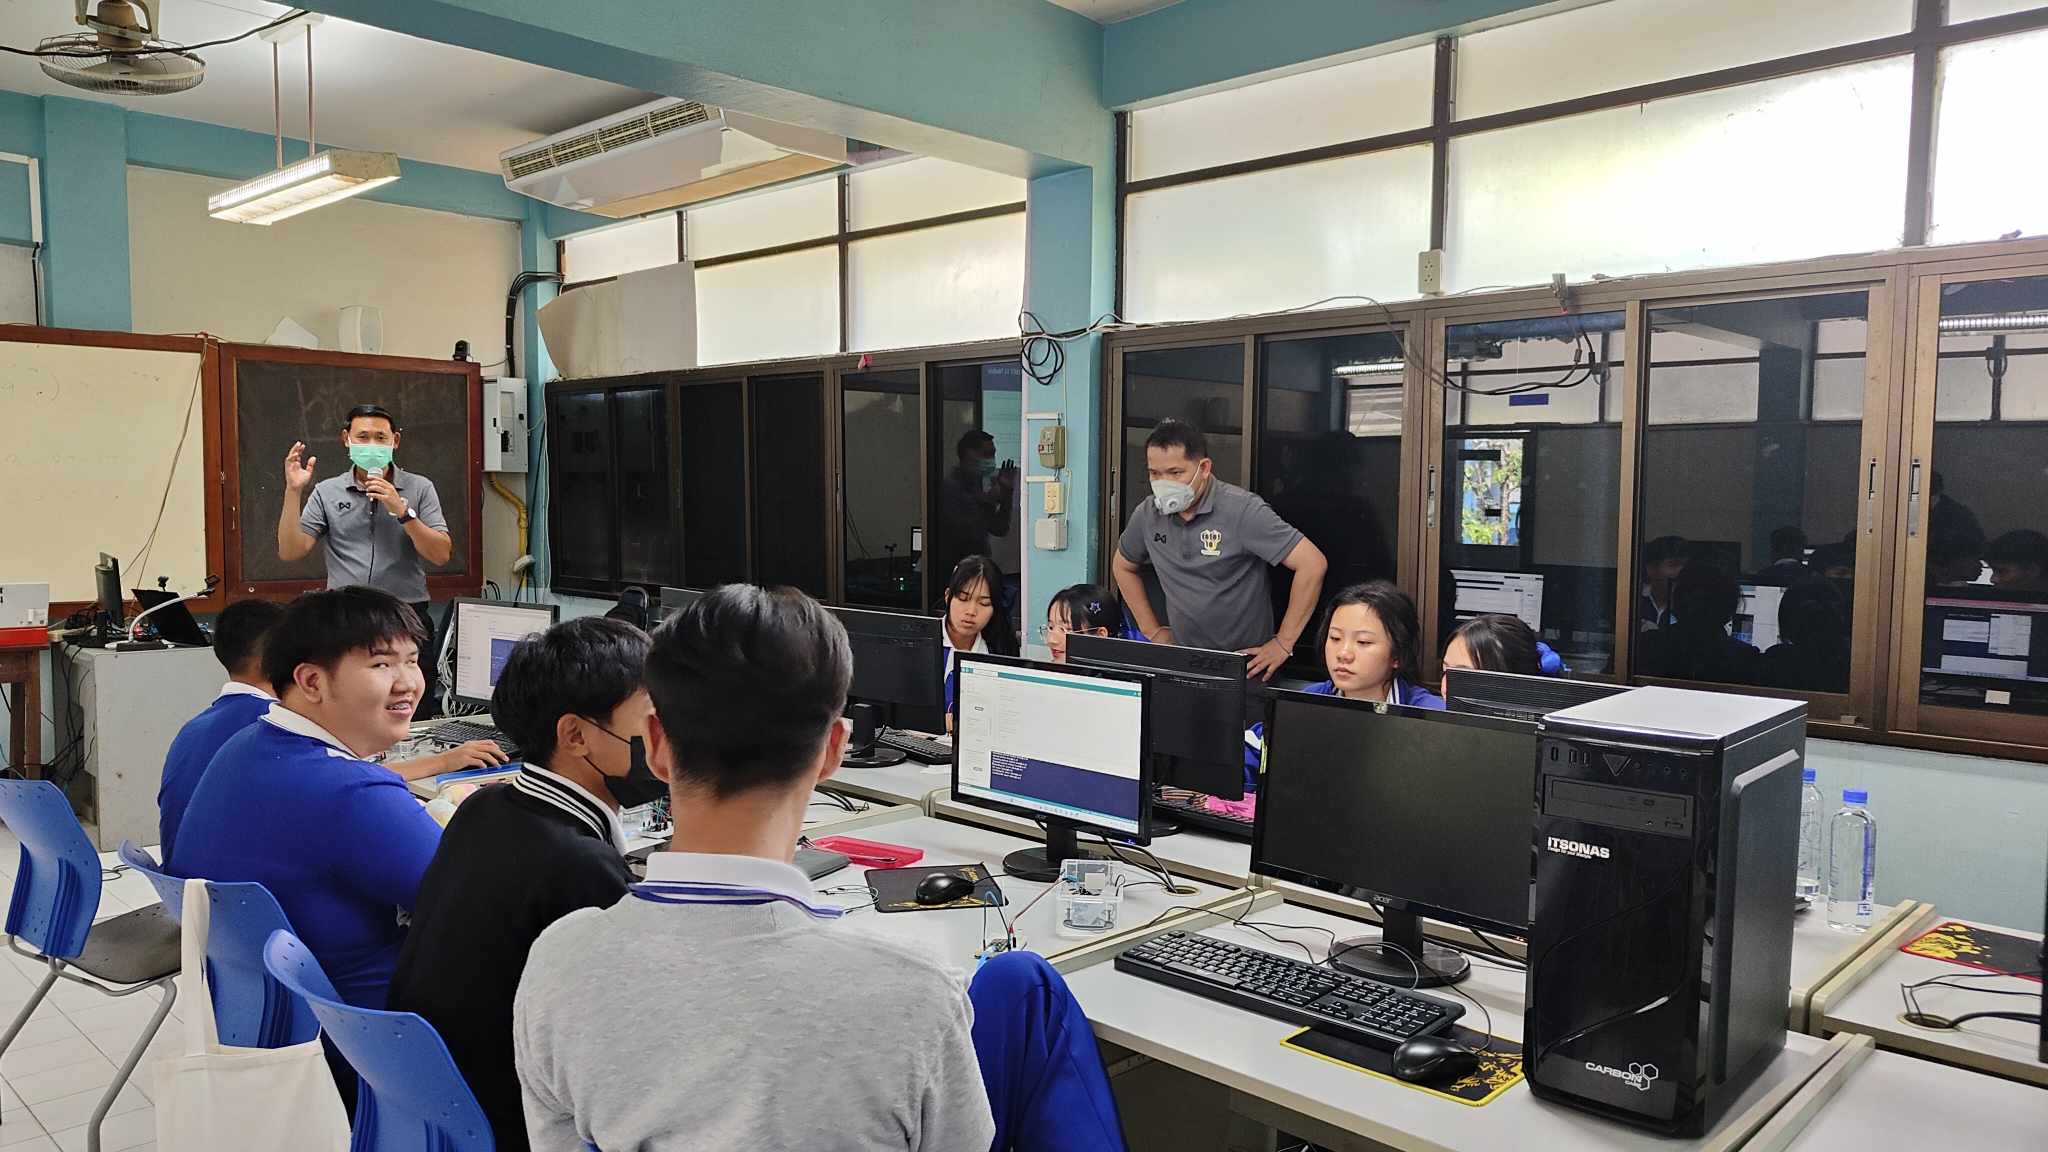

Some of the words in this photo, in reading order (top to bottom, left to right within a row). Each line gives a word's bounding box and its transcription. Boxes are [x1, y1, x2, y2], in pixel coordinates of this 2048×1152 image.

[1547, 836, 1610, 859] ITSONAS
[1372, 894, 1393, 904] acer
[1585, 1062, 1643, 1083] CARBON
